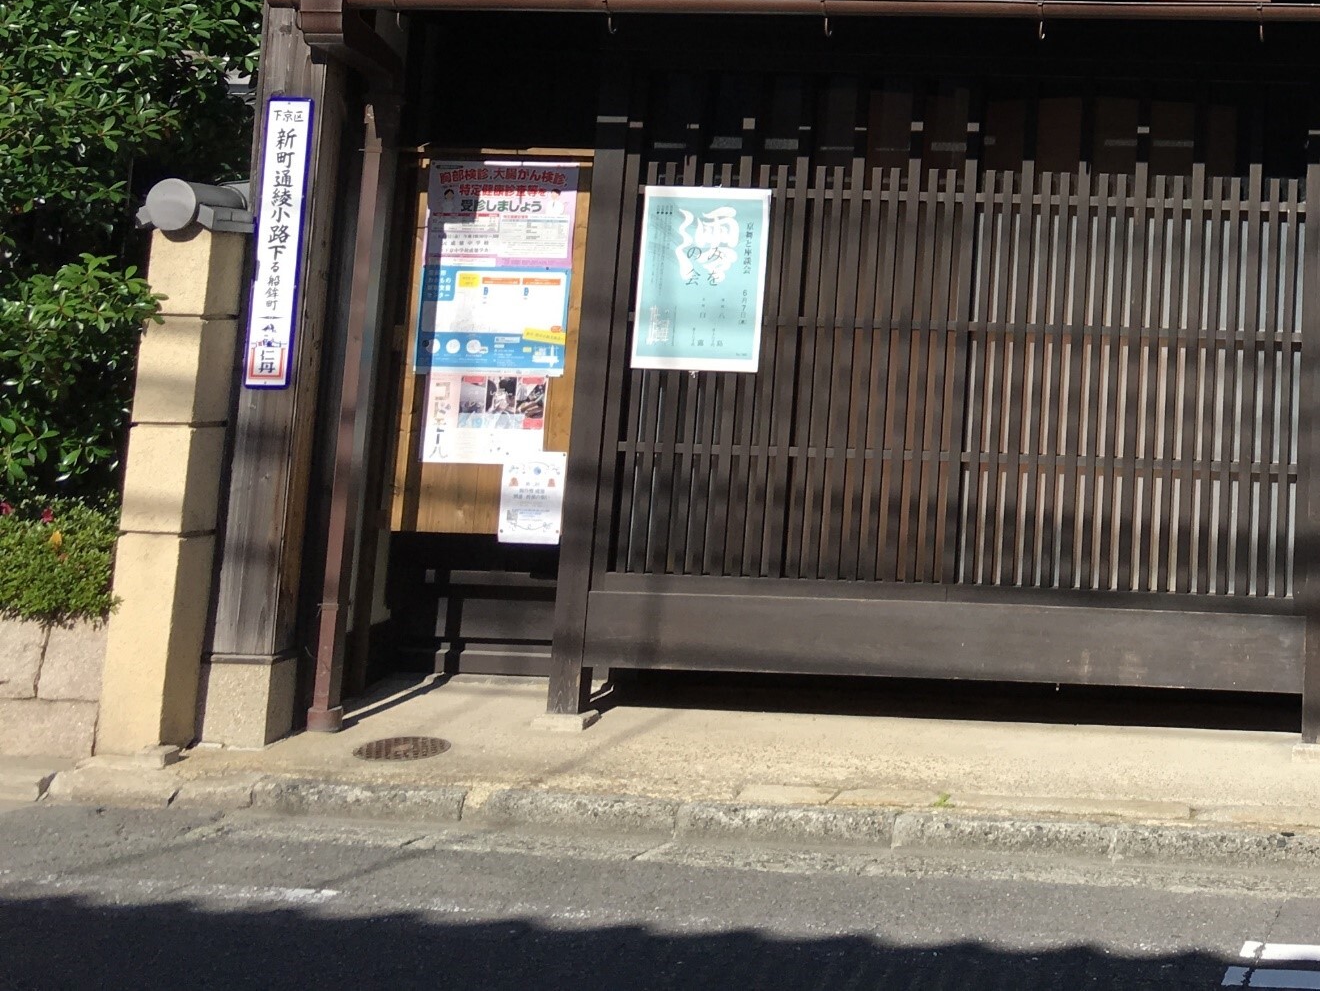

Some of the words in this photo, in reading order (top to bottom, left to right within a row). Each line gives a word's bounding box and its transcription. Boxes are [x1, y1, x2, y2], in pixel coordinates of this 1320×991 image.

[273, 110, 304, 122] 下京区
[461, 199, 542, 212] 受診しましょう
[685, 246, 703, 287] の会
[259, 350, 275, 374] 仁丹
